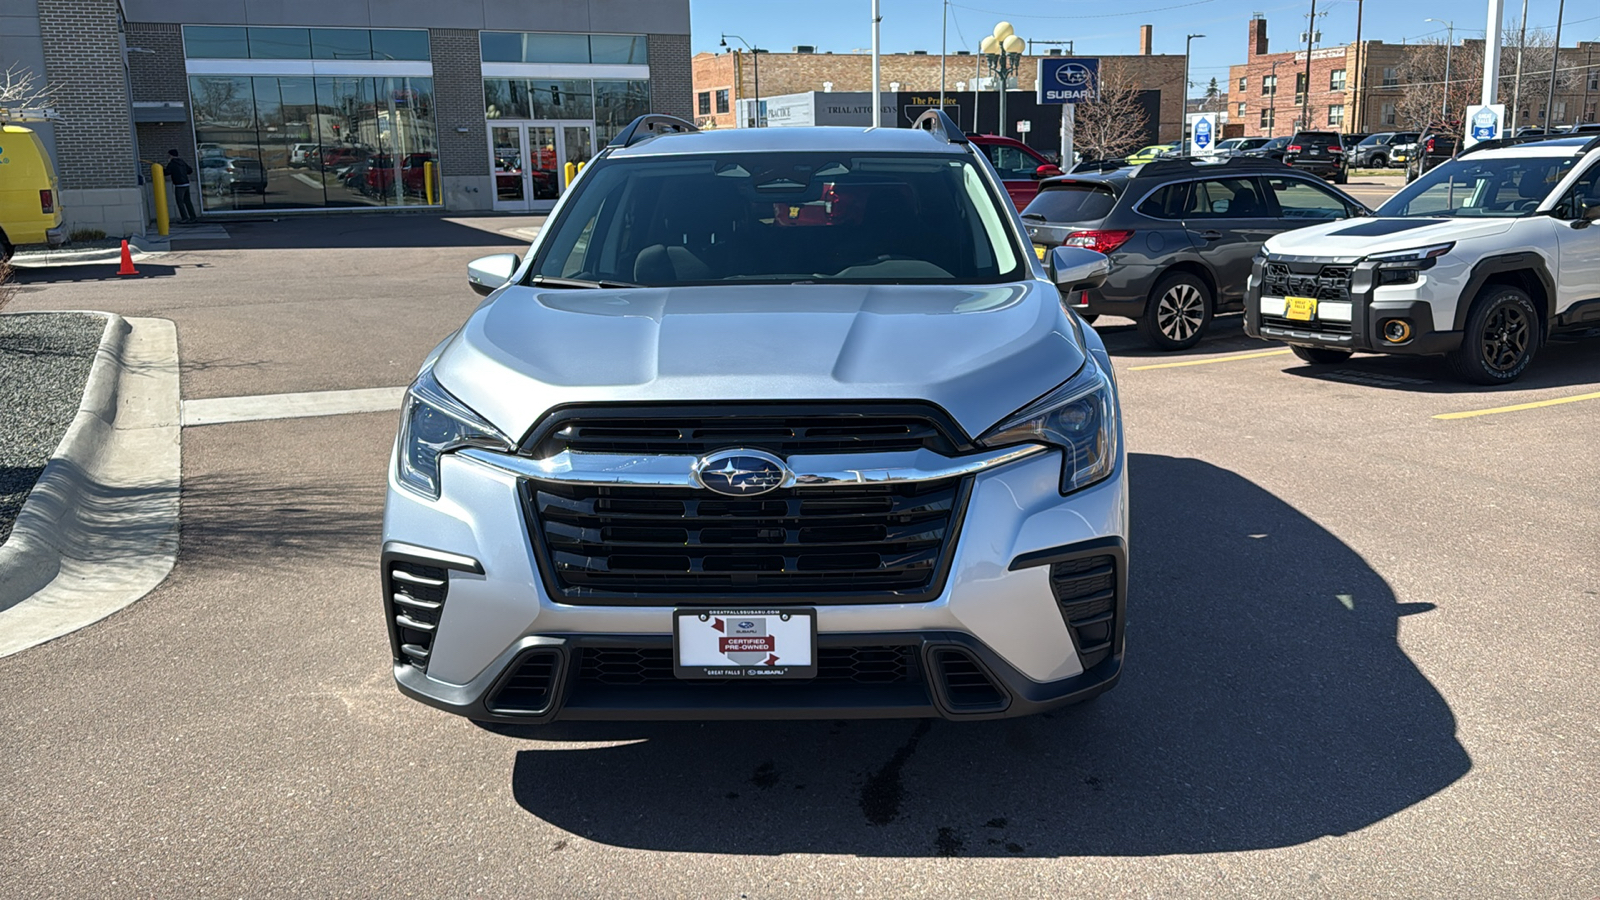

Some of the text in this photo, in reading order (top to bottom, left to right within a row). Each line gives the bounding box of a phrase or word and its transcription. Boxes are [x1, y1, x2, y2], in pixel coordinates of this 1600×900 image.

[1046, 90, 1096, 99] SUBARU
[912, 96, 957, 105] The Pratice
[768, 107, 791, 118] PRACTICE
[827, 106, 898, 114] TRIAL ATTONEYS
[1265, 274, 1350, 288] SUBARU
